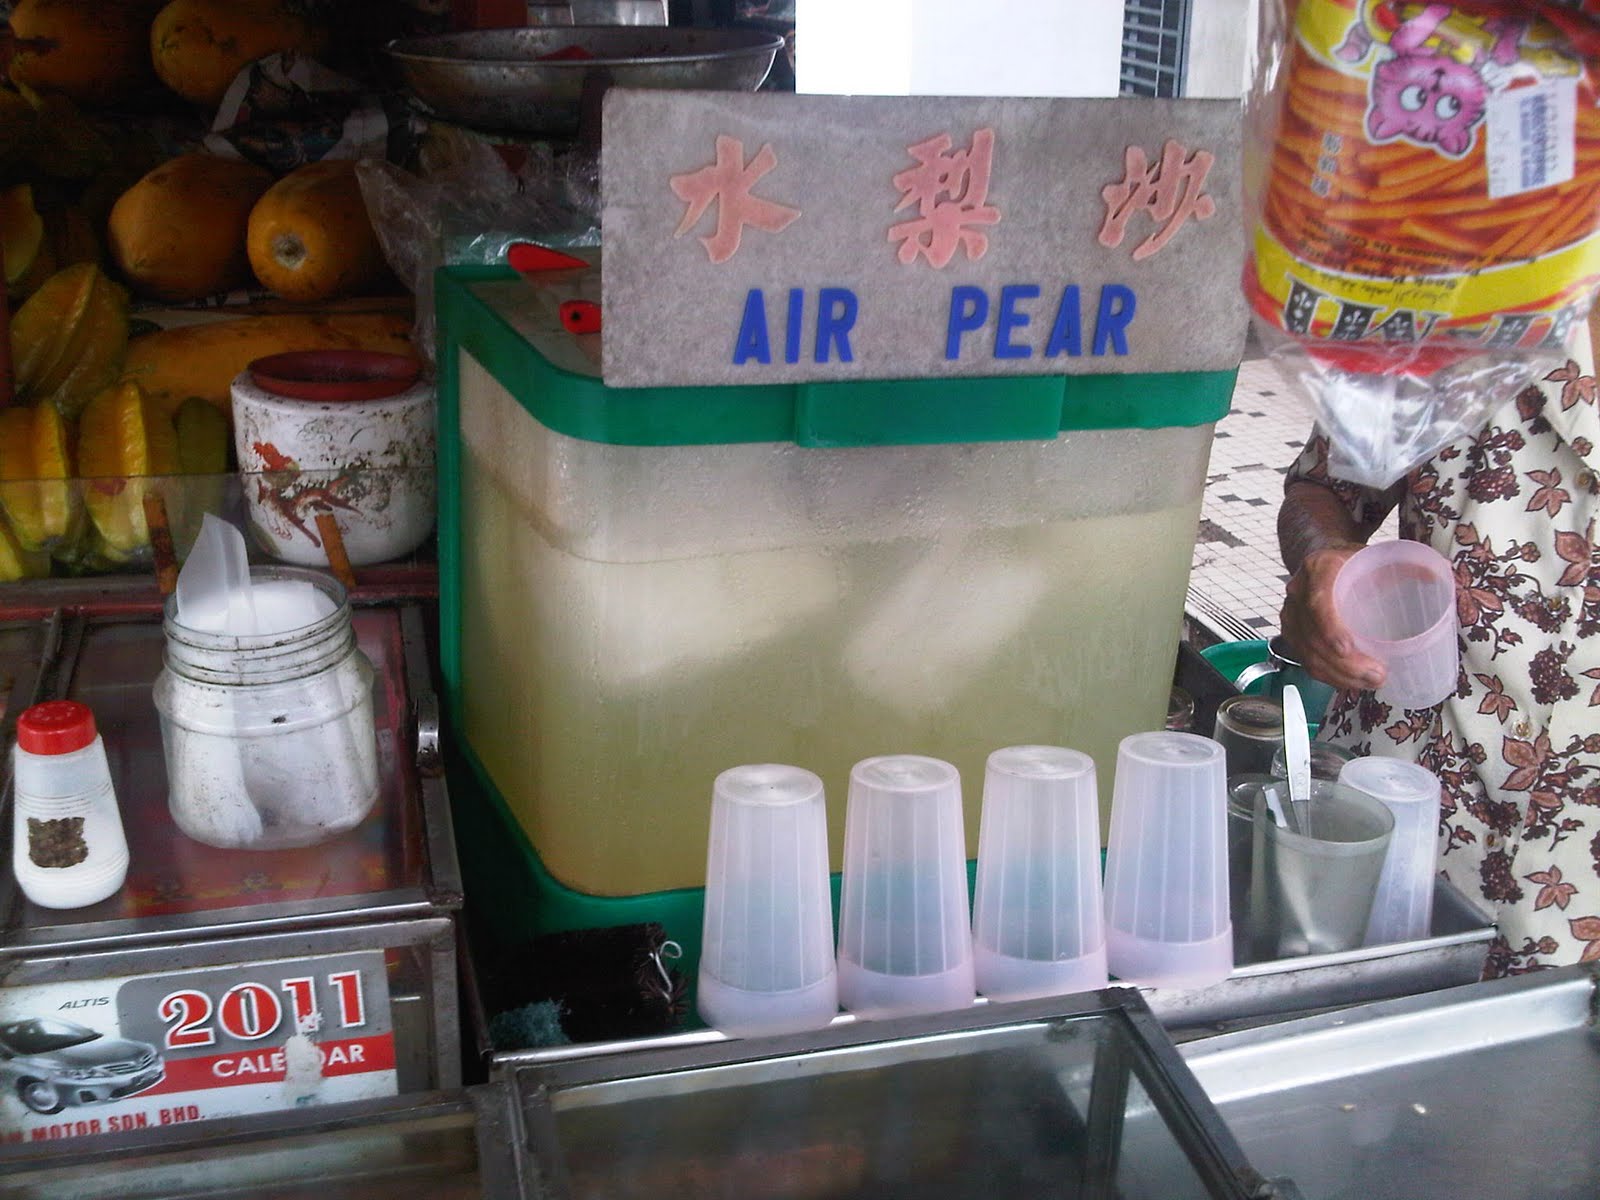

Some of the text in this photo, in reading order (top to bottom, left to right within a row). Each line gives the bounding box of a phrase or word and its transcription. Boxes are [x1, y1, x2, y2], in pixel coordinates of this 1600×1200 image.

[733, 284, 1137, 366] AIR PEAR
[58, 996, 110, 1011] ALTIS
[158, 969, 366, 1050] 2011
[212, 1044, 365, 1077] CALEAR
[31, 1118, 102, 1142] MOTOR
[159, 1104, 206, 1126] BHD.
